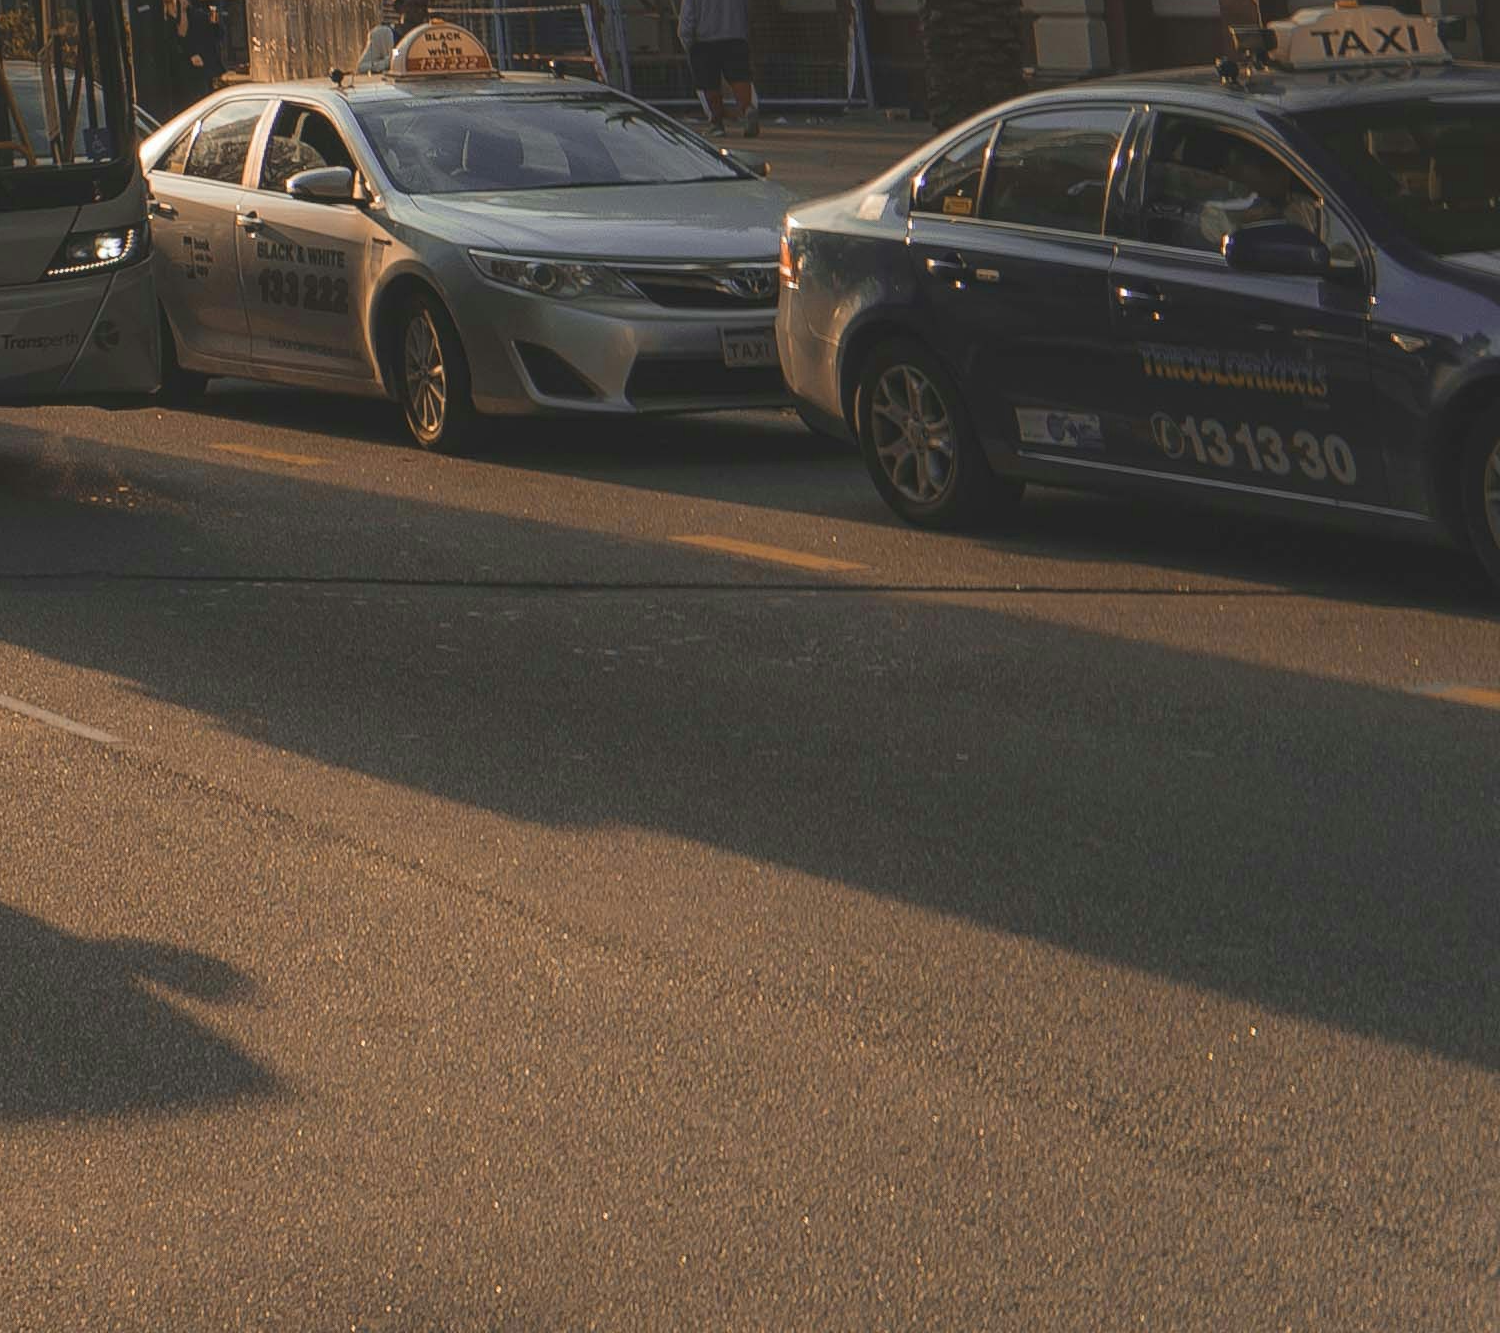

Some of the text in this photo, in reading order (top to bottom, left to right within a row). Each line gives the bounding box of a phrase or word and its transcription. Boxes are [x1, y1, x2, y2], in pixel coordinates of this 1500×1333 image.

[425, 31, 462, 42] BLACK
[1310, 26, 1420, 57] TAXI
[428, 47, 463, 57] WHITE
[257, 241, 347, 269] BLACK & WHITE
[258, 268, 350, 314] 133 222
[0, 328, 80, 354] Transperth
[1181, 415, 1359, 486] 13 13 30
